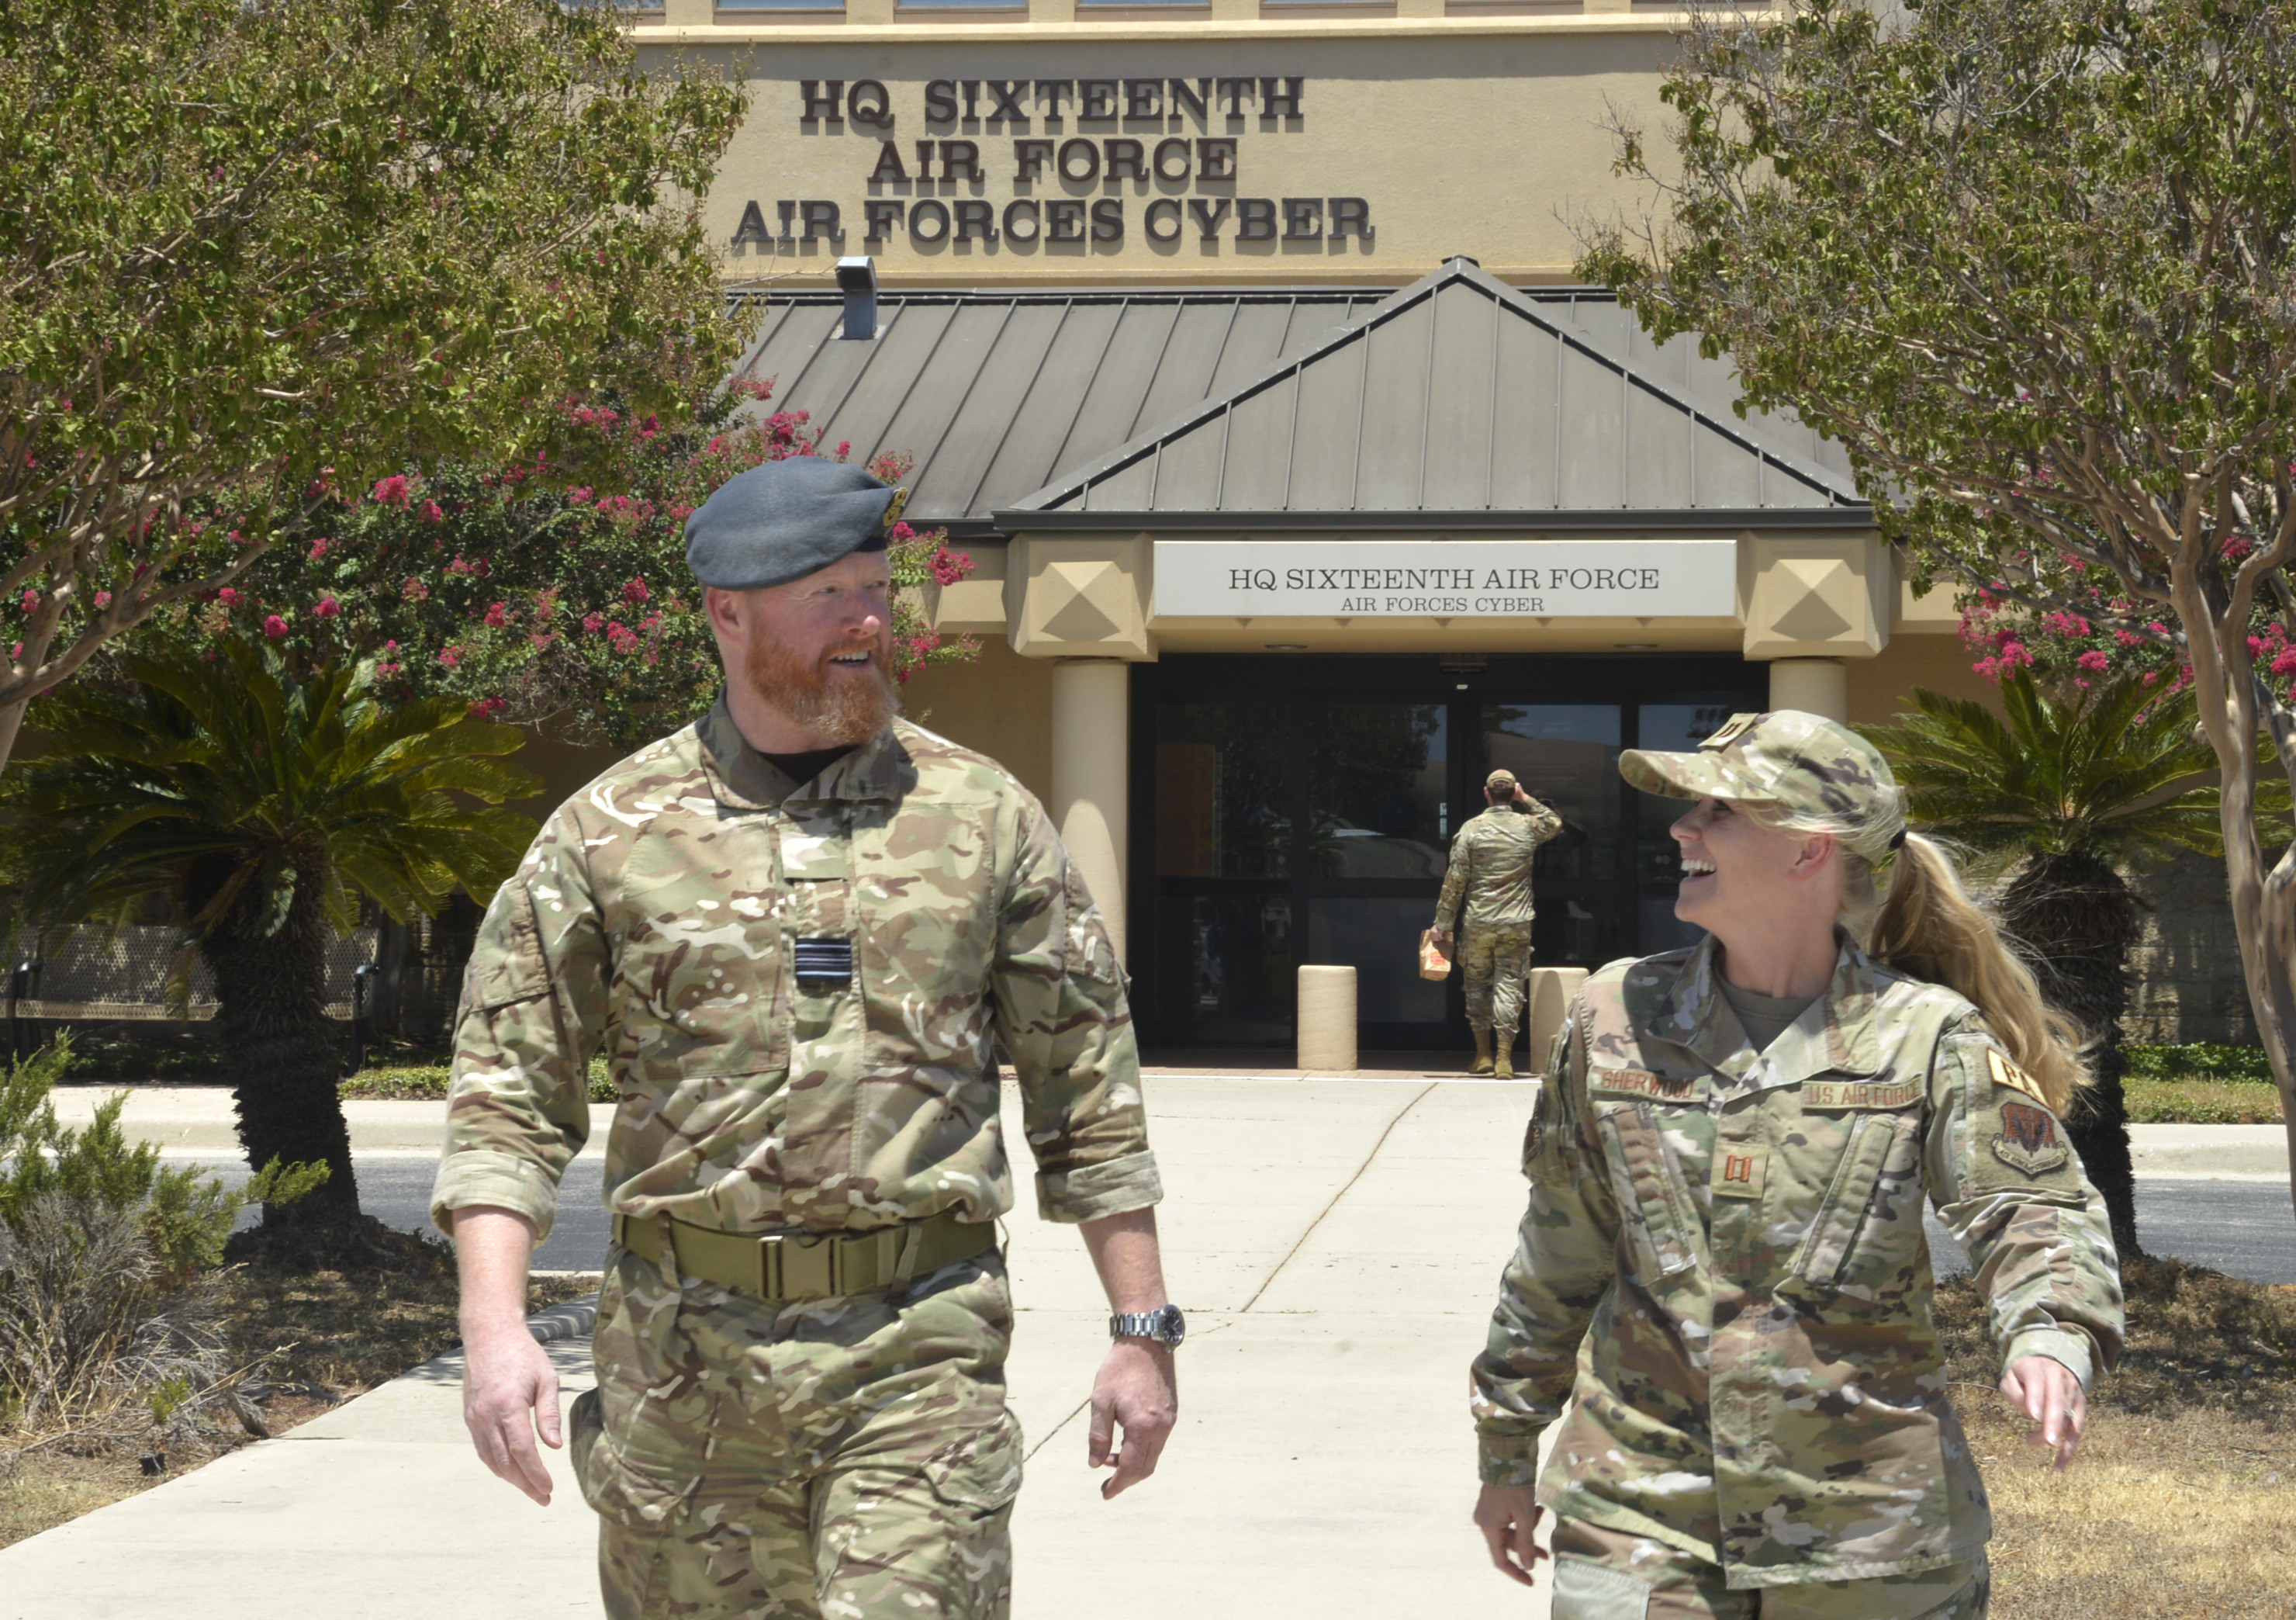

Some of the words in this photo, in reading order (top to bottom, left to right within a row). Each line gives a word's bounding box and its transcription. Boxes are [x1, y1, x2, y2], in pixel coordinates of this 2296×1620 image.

[800, 78, 895, 129] HQ
[925, 77, 1305, 123] SIXTEENTH
[867, 140, 985, 182] AIR
[1013, 137, 1237, 182] FORCE
[731, 199, 846, 242] AIR
[863, 199, 1124, 242] FORCES
[1144, 197, 1375, 242] CYBER
[1228, 568, 1278, 591] HQ
[1285, 568, 1475, 590] SIXTEENTH
[1482, 568, 1541, 590] AIR
[1548, 568, 1659, 590] FORCE
[1340, 597, 1378, 612] AIR
[1385, 597, 1468, 612] FORCES
[1475, 597, 1545, 612] CYBER
[1601, 1069, 1696, 1099] SHERWOOD
[1841, 1085, 1869, 1105] AIR
[1874, 1078, 1921, 1106] FORCE
